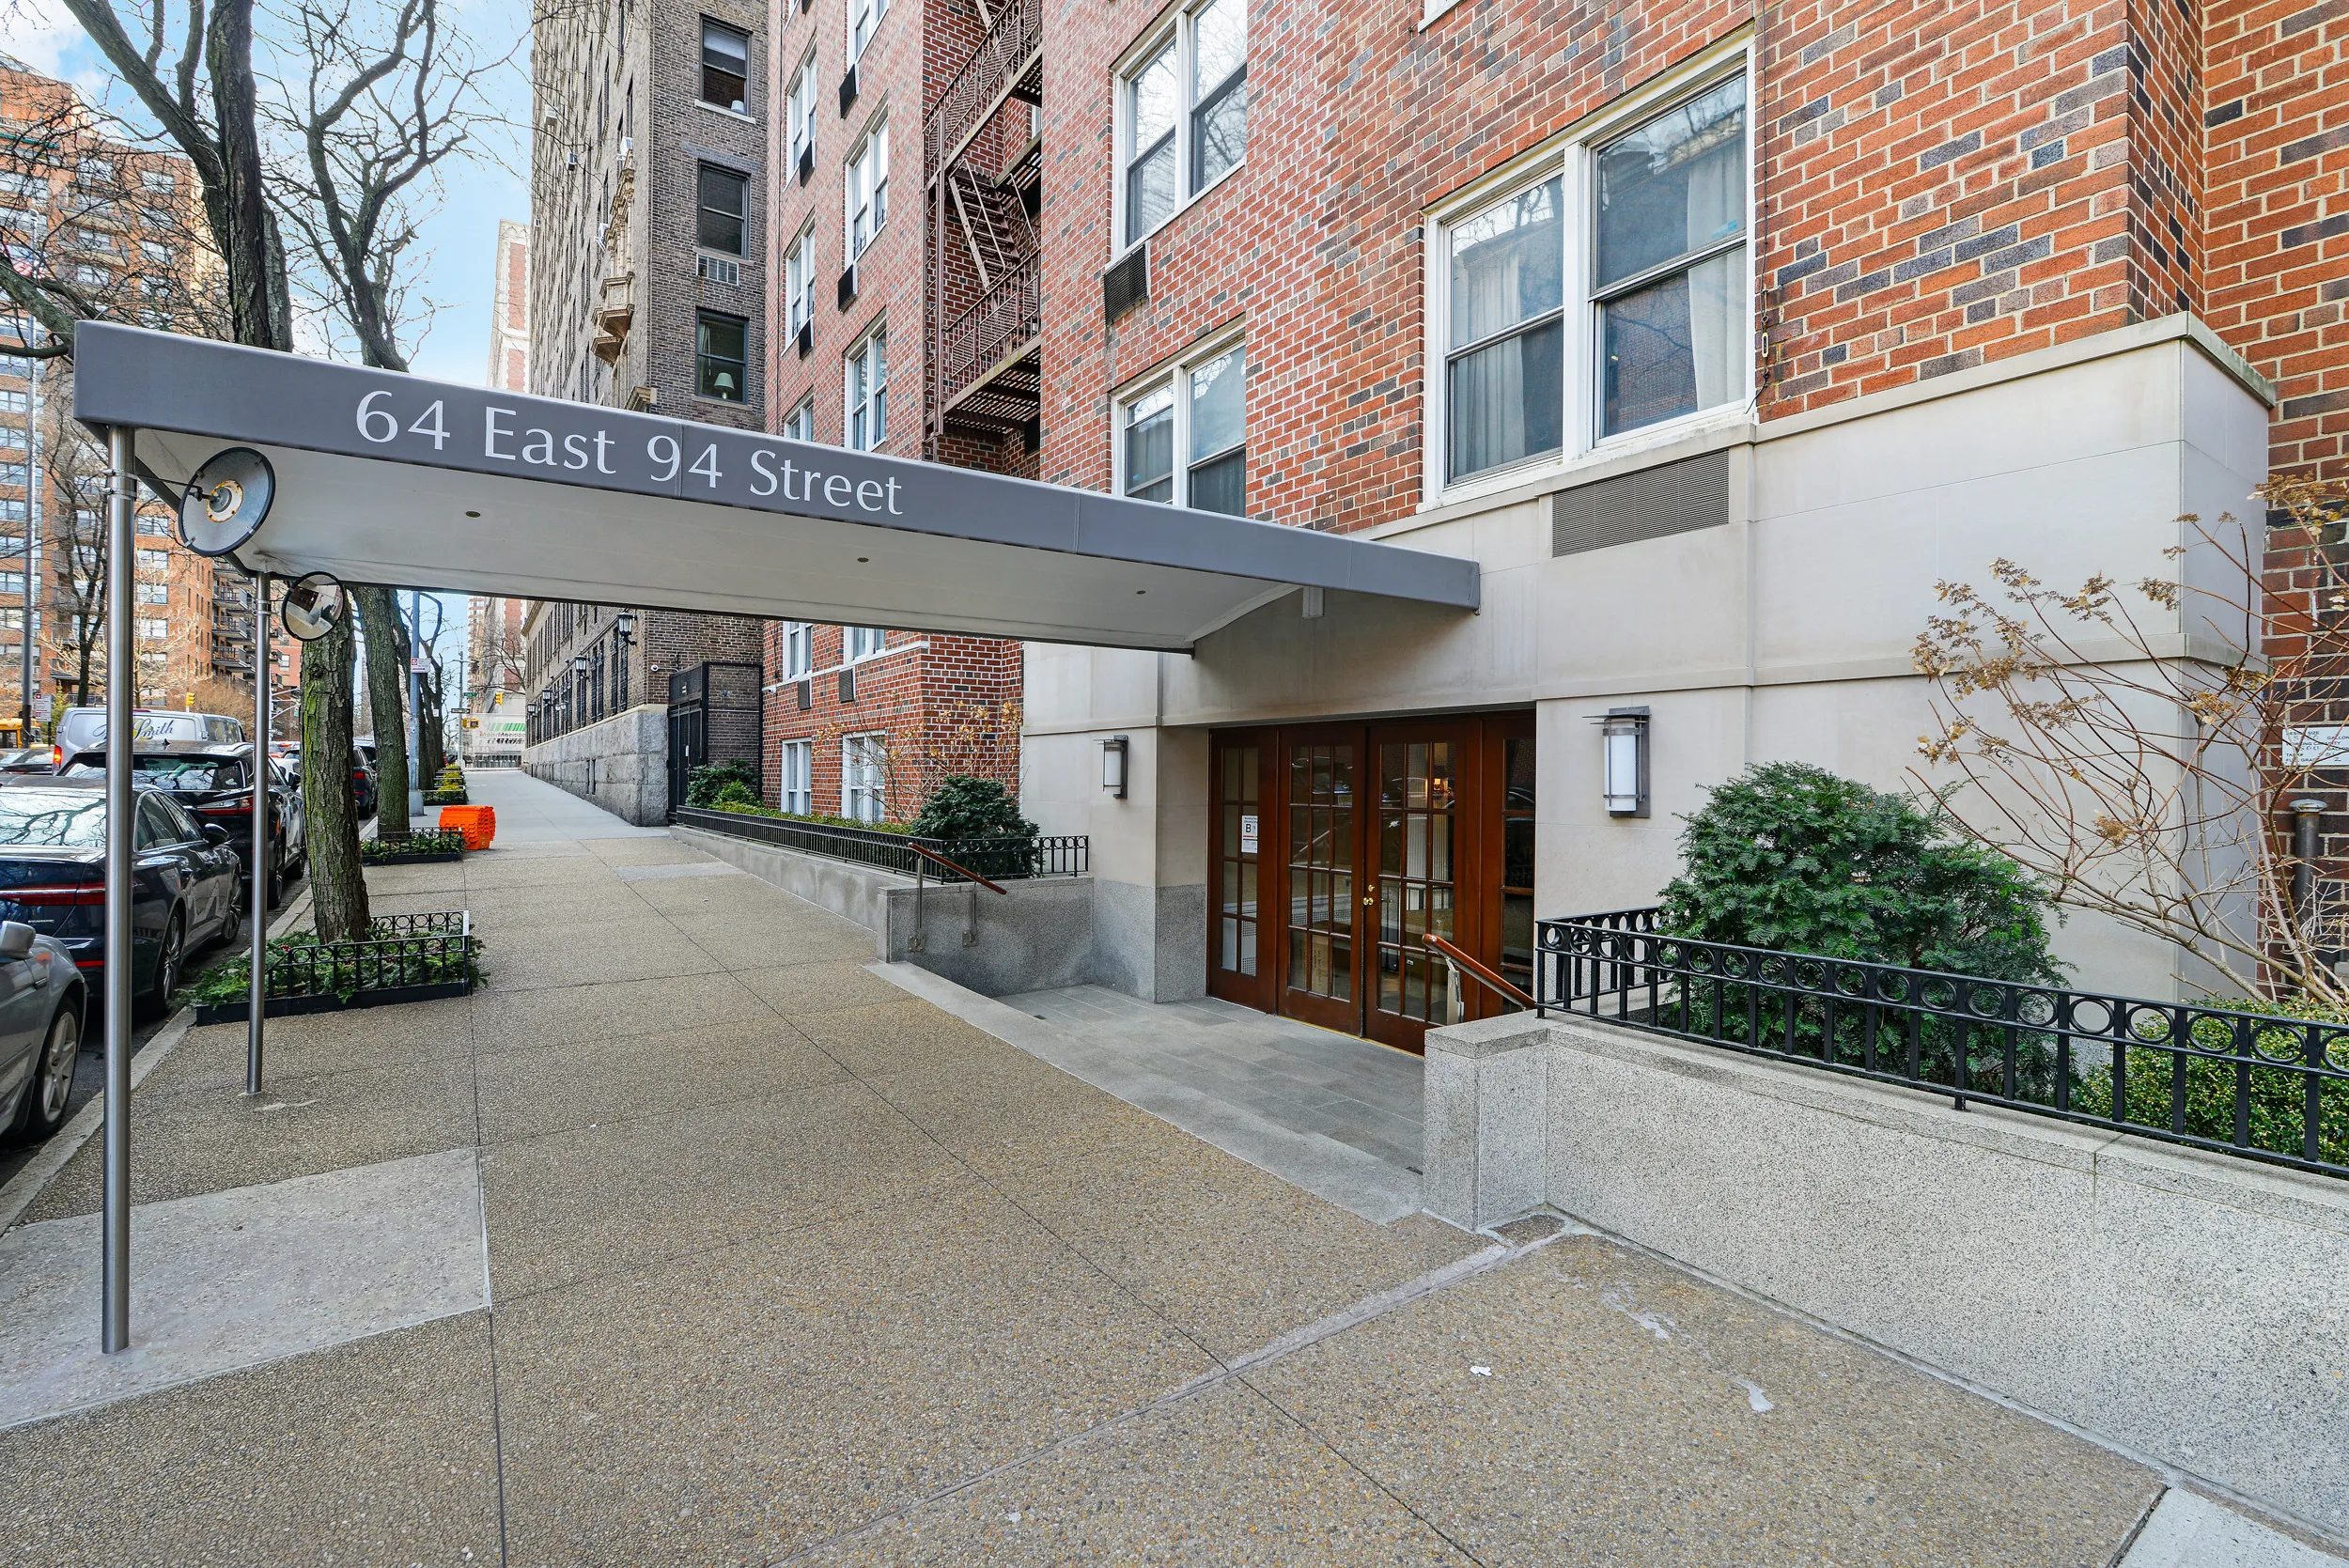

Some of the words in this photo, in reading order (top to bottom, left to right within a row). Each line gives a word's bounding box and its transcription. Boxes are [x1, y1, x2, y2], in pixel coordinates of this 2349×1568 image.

[357, 391, 450, 450] 64
[486, 407, 615, 474] East
[647, 436, 722, 488] 94
[751, 450, 902, 514] Street
[1245, 824, 1252, 833] B
